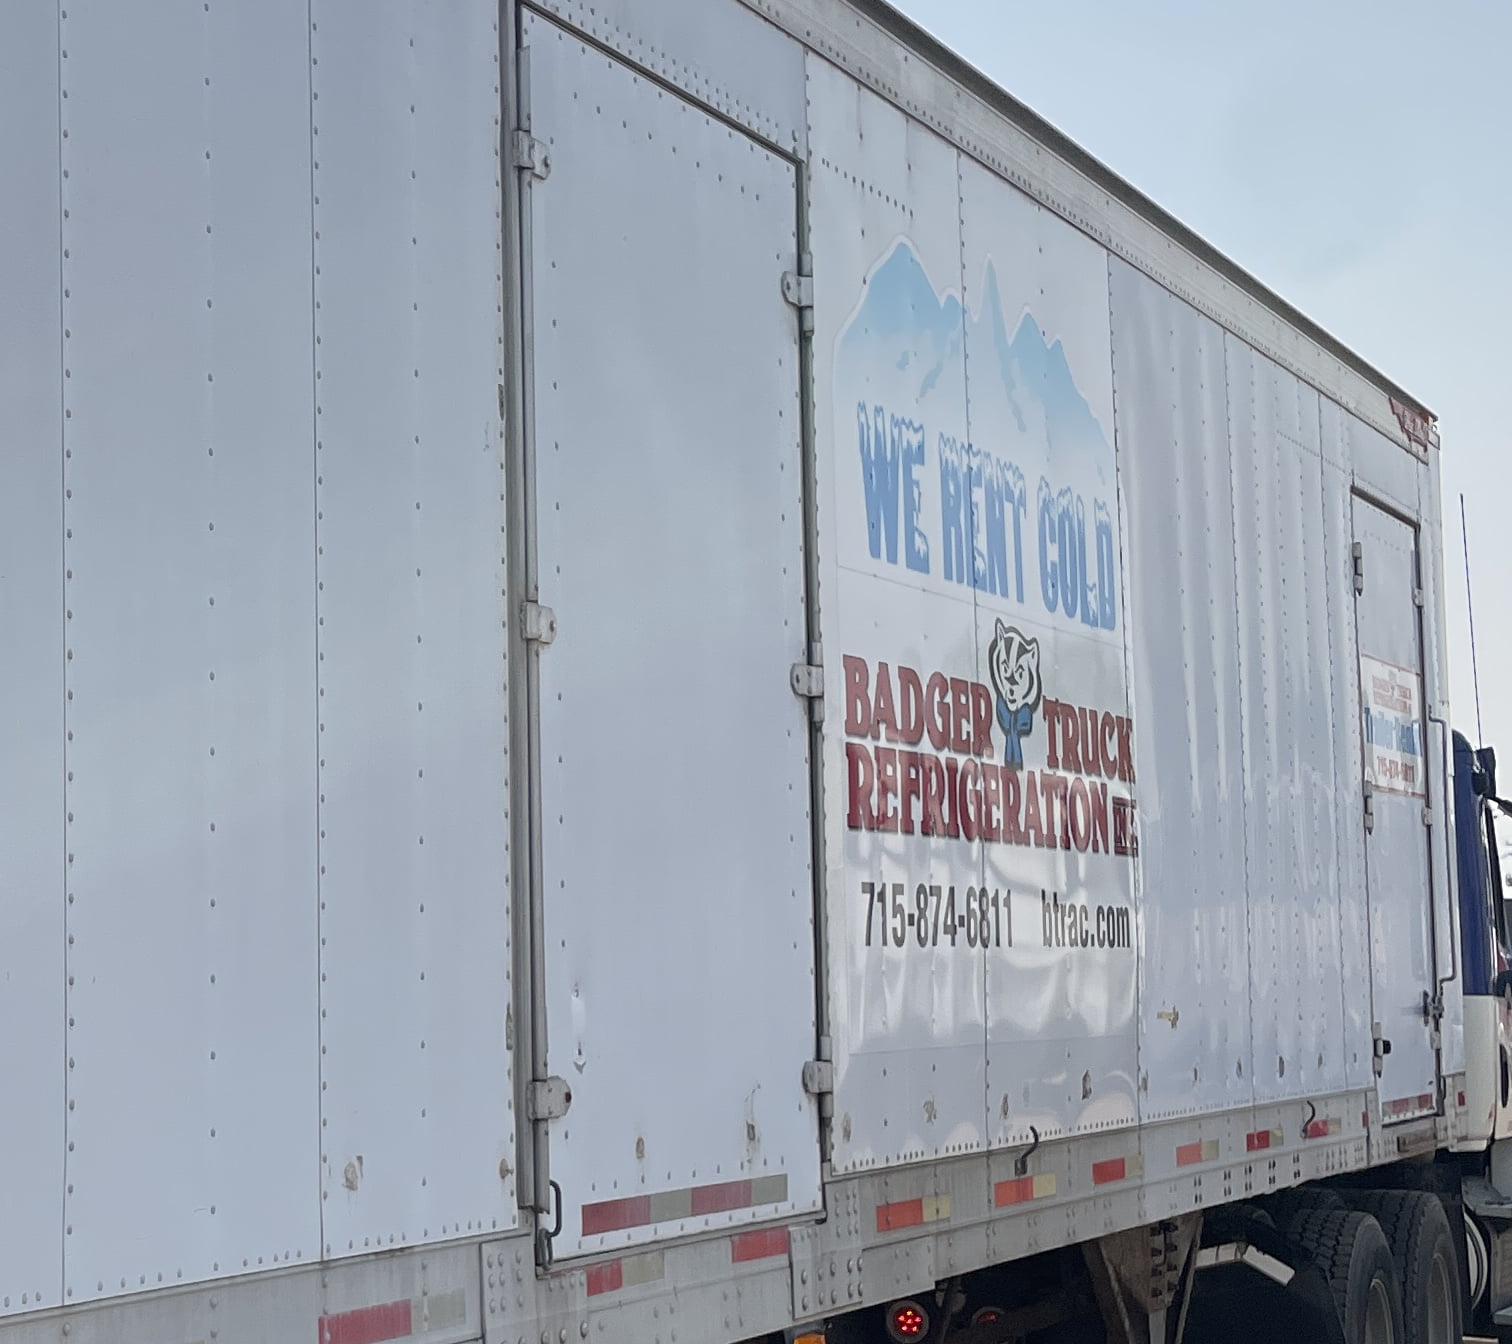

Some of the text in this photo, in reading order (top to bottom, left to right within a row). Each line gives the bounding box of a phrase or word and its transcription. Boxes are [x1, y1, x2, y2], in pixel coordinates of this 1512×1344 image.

[857, 400, 1116, 631] WE RENT COLD
[843, 654, 1136, 784] BADGER TRUCK
[845, 742, 1109, 855] REFRIGERATION
[861, 881, 1131, 949] 715-874-6811 btrac.com
